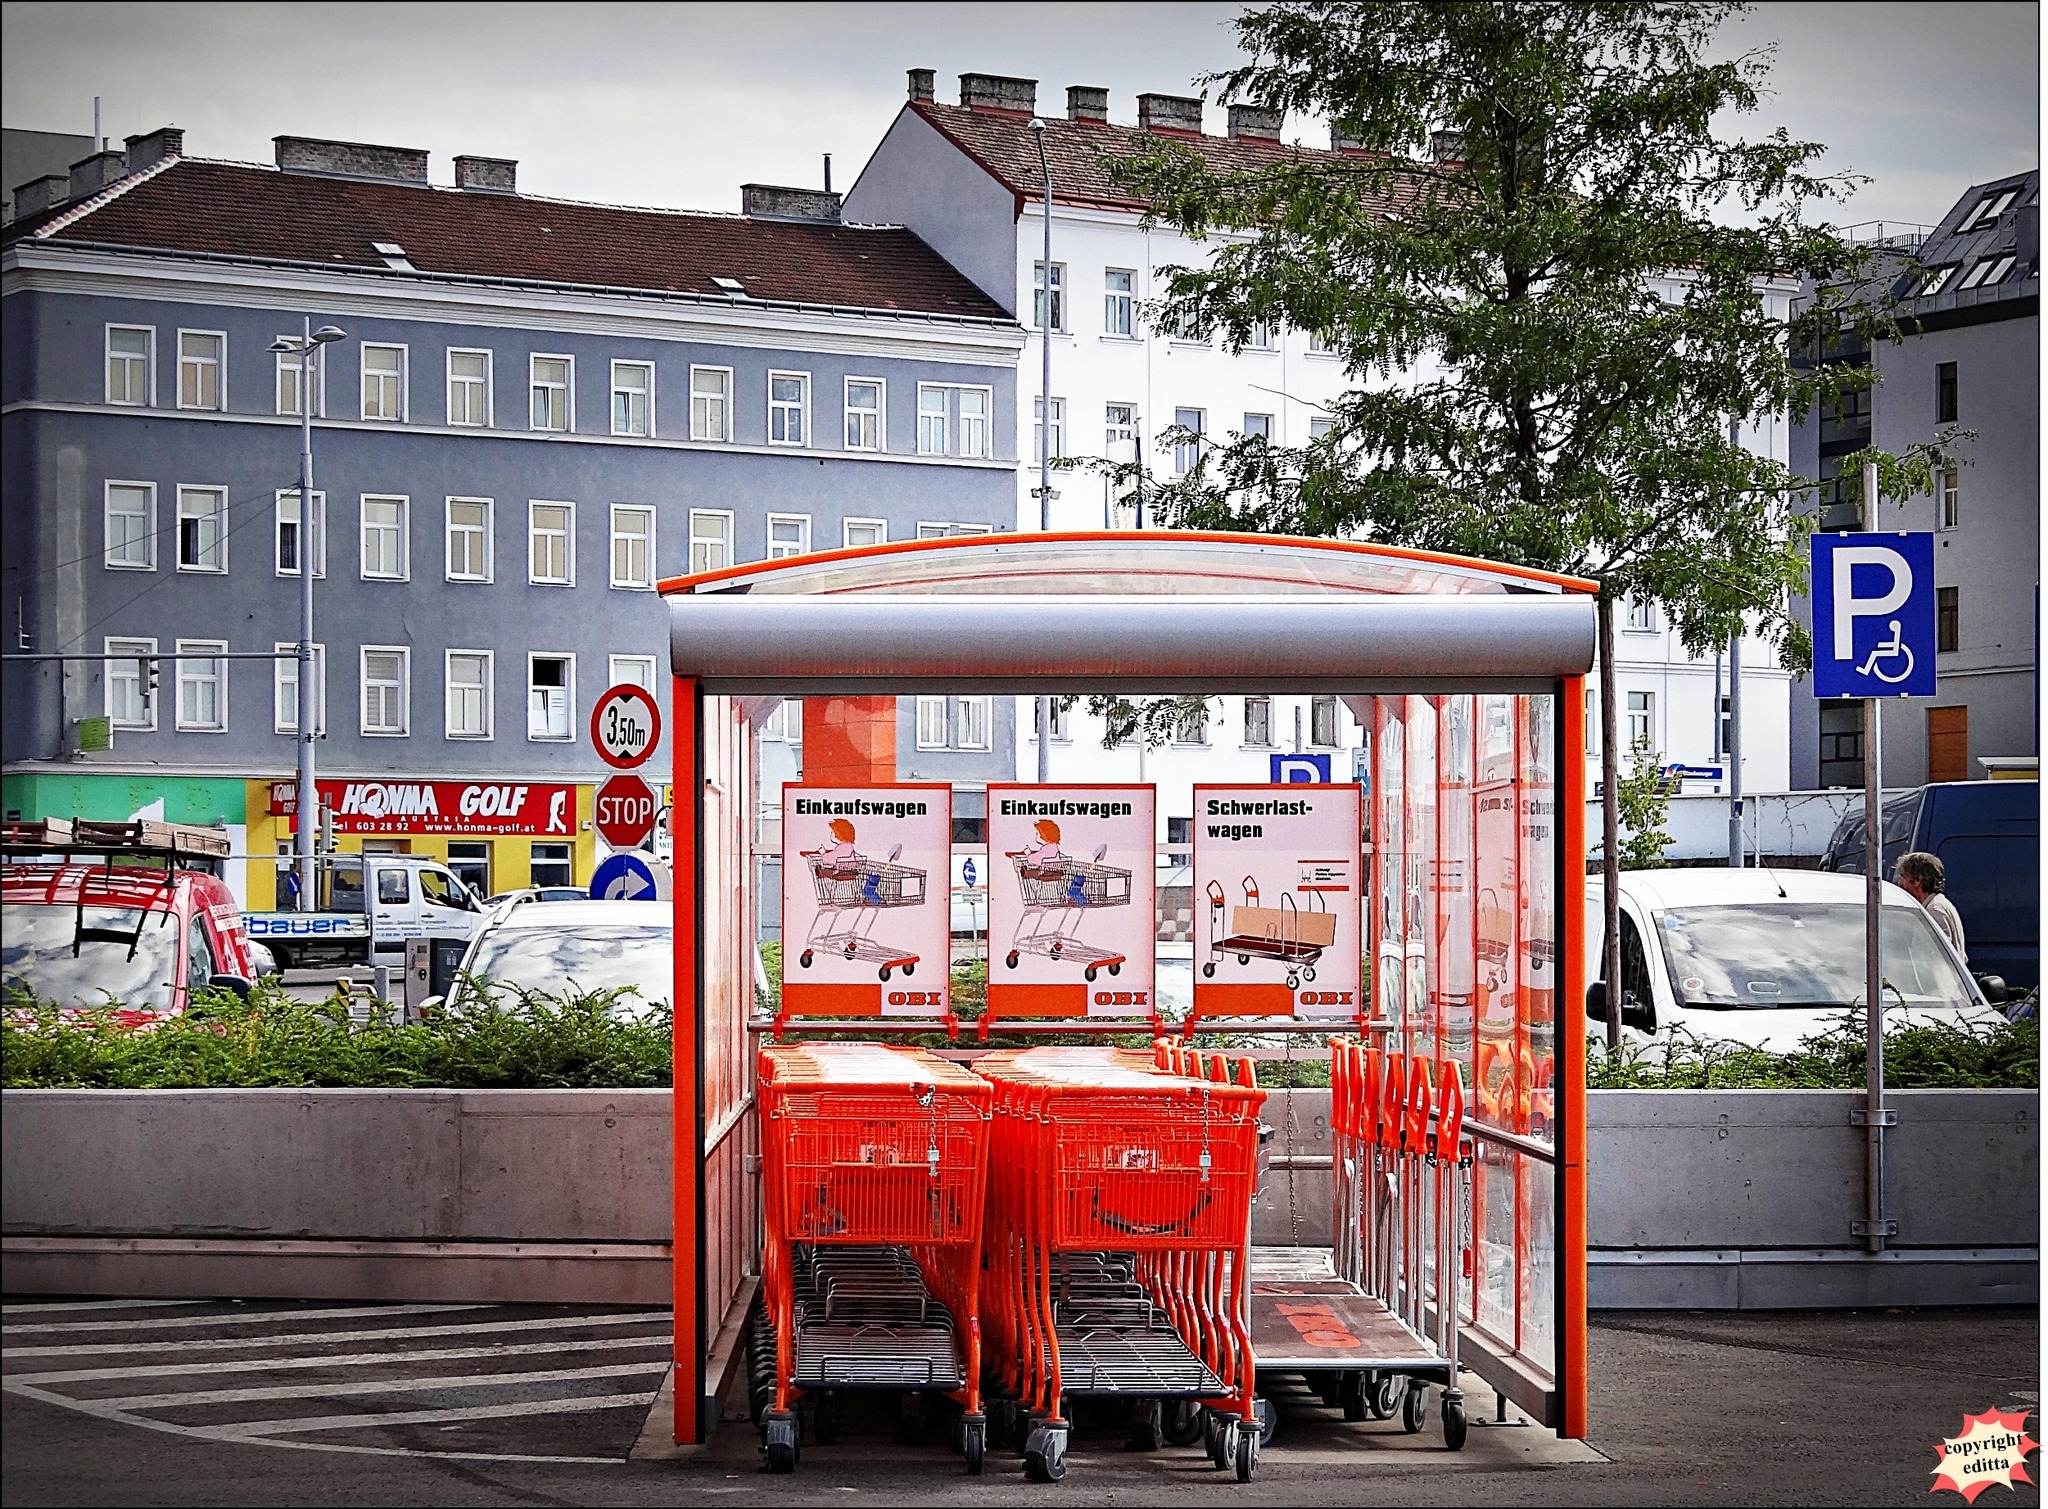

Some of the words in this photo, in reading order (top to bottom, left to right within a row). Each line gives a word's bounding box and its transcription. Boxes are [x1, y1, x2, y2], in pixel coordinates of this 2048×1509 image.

[1833, 546, 1913, 661] P
[607, 705, 646, 747] 3,50m
[341, 784, 438, 818] HONMA
[459, 786, 528, 816] GOLF
[796, 799, 926, 818] Einkaufswagen
[1001, 799, 1132, 818] Einkaufswagen
[1207, 800, 1313, 816] Schwerlast-
[400, 815, 470, 823] AUSTRIA
[599, 797, 651, 825] STOP
[356, 821, 376, 831] 603
[379, 821, 392, 831] 28
[396, 822, 409, 832] 92
[424, 823, 535, 834] www.honma-golf.at
[1207, 824, 1263, 841] wagen
[888, 991, 942, 1006] OBI
[1093, 991, 1148, 1006] OBI
[1299, 991, 1354, 1006] OBI
